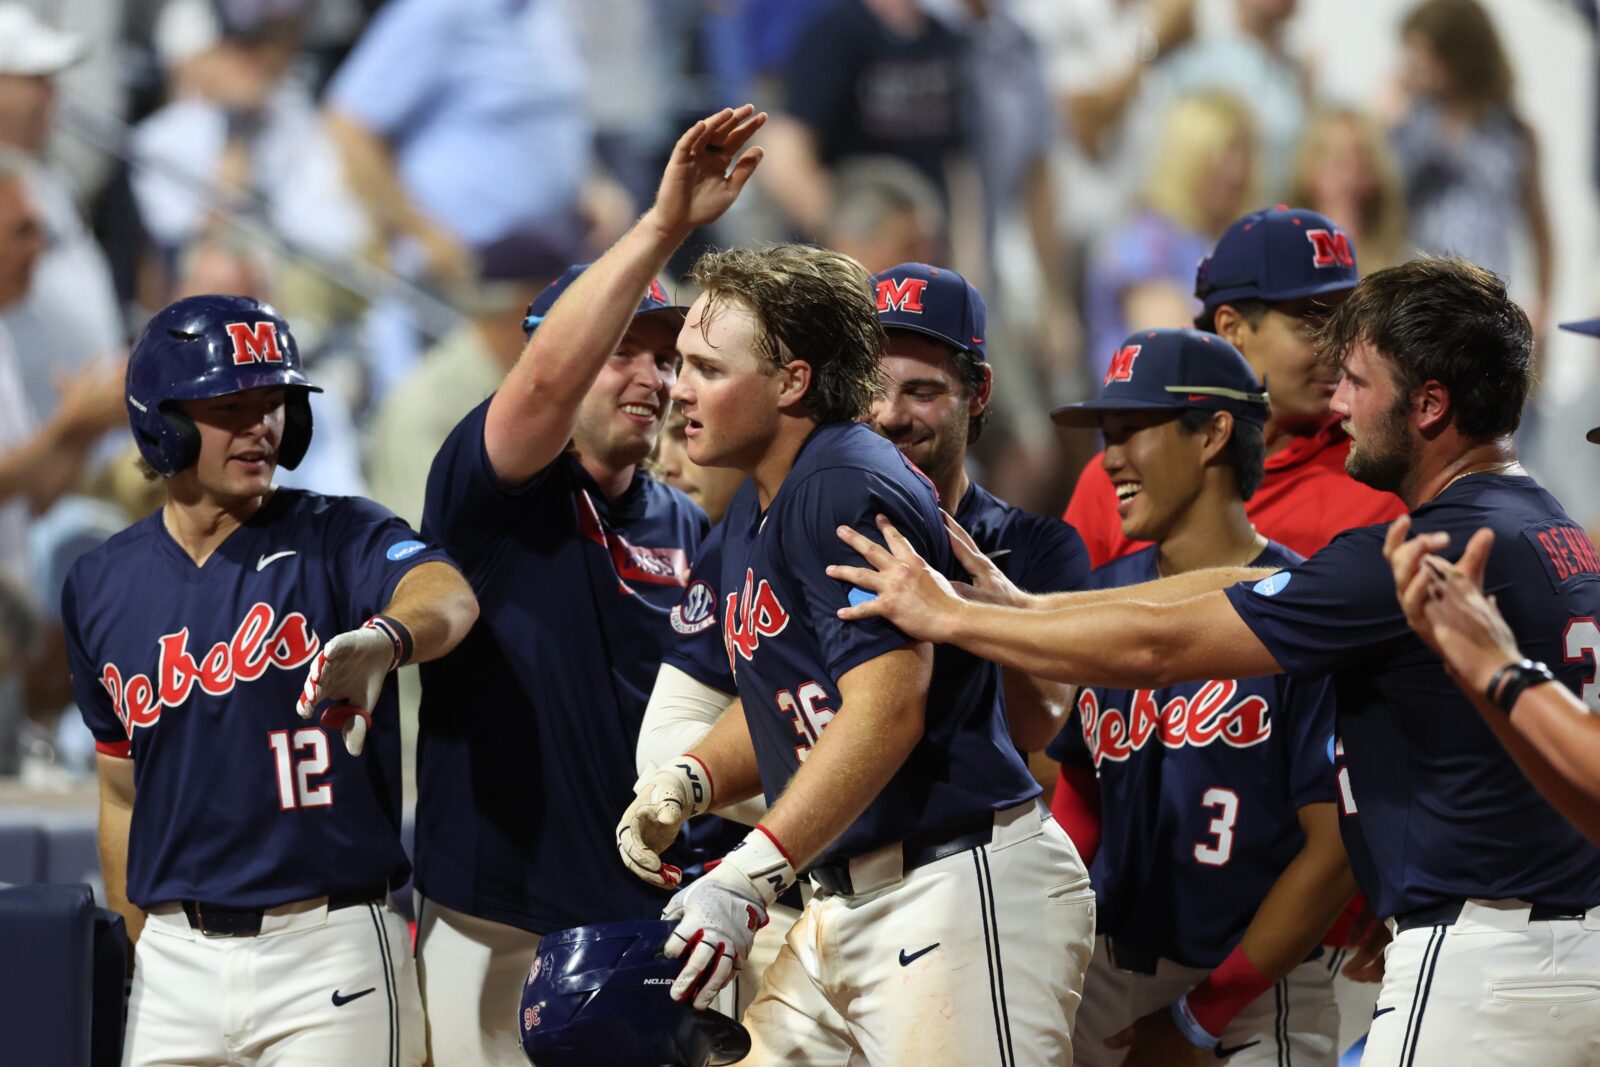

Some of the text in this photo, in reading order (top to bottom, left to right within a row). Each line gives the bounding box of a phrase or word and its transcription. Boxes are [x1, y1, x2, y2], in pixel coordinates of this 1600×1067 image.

[1306, 229, 1353, 268] M
[876, 278, 927, 315] M
[226, 321, 283, 366] M
[1104, 345, 1142, 387] M
[1537, 526, 1600, 581] BENN
[99, 601, 320, 741] Rebels
[775, 680, 837, 767] 36
[1078, 679, 1272, 778] Rebels
[268, 726, 333, 811] 12
[1193, 786, 1240, 867] 3
[524, 1004, 541, 1031] 36
